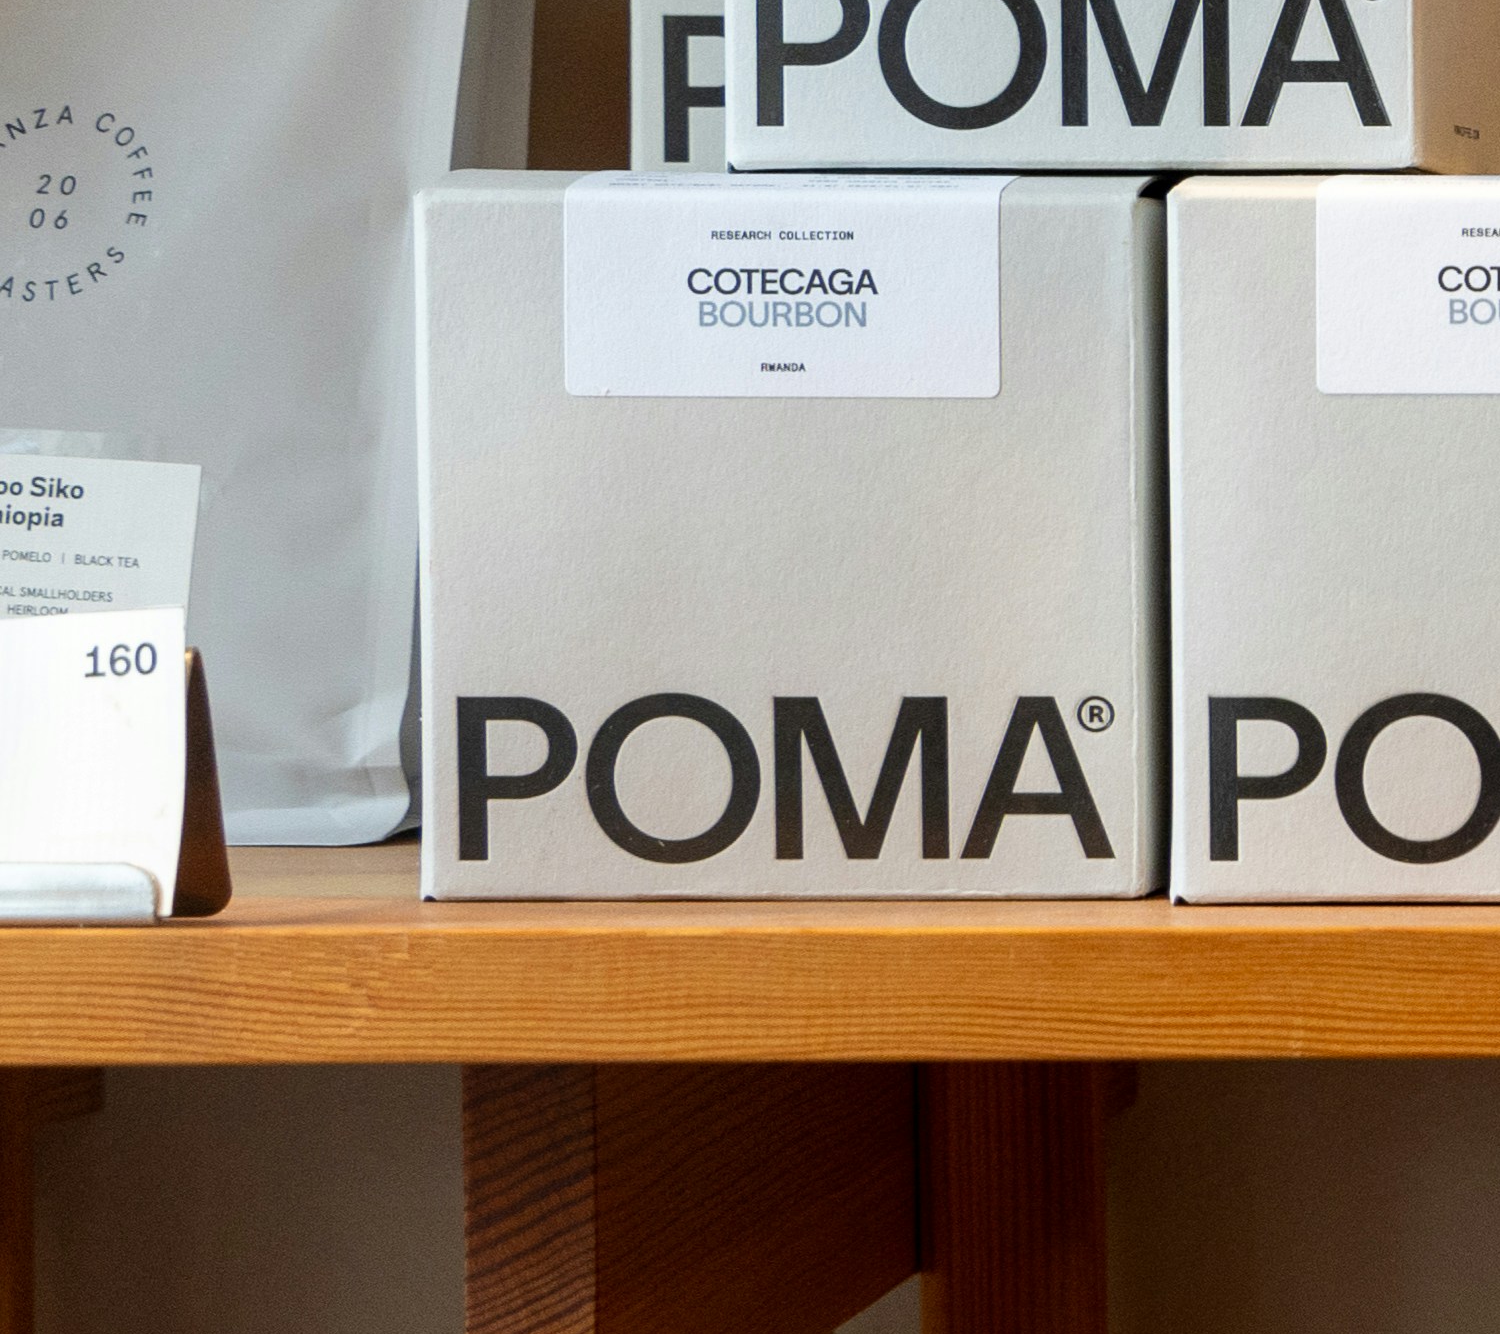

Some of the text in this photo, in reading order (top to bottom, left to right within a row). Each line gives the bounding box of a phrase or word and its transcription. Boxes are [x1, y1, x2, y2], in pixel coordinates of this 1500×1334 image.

[0, 105, 154, 227] NZA COFFEE
[36, 174, 77, 196] 20
[29, 208, 68, 230] 06
[710, 230, 855, 241] RESEARCH COLLECTION
[0, 246, 125, 302] ASTERS
[687, 267, 879, 296] COTECAGA
[698, 300, 867, 328] BOURBON
[760, 362, 806, 373] RWANDA
[30, 476, 84, 500] Siko
[2, 549, 141, 569] POMELO BLACK TEA
[20, 587, 114, 603] SMALLHOLDERS
[84, 642, 158, 678] 160
